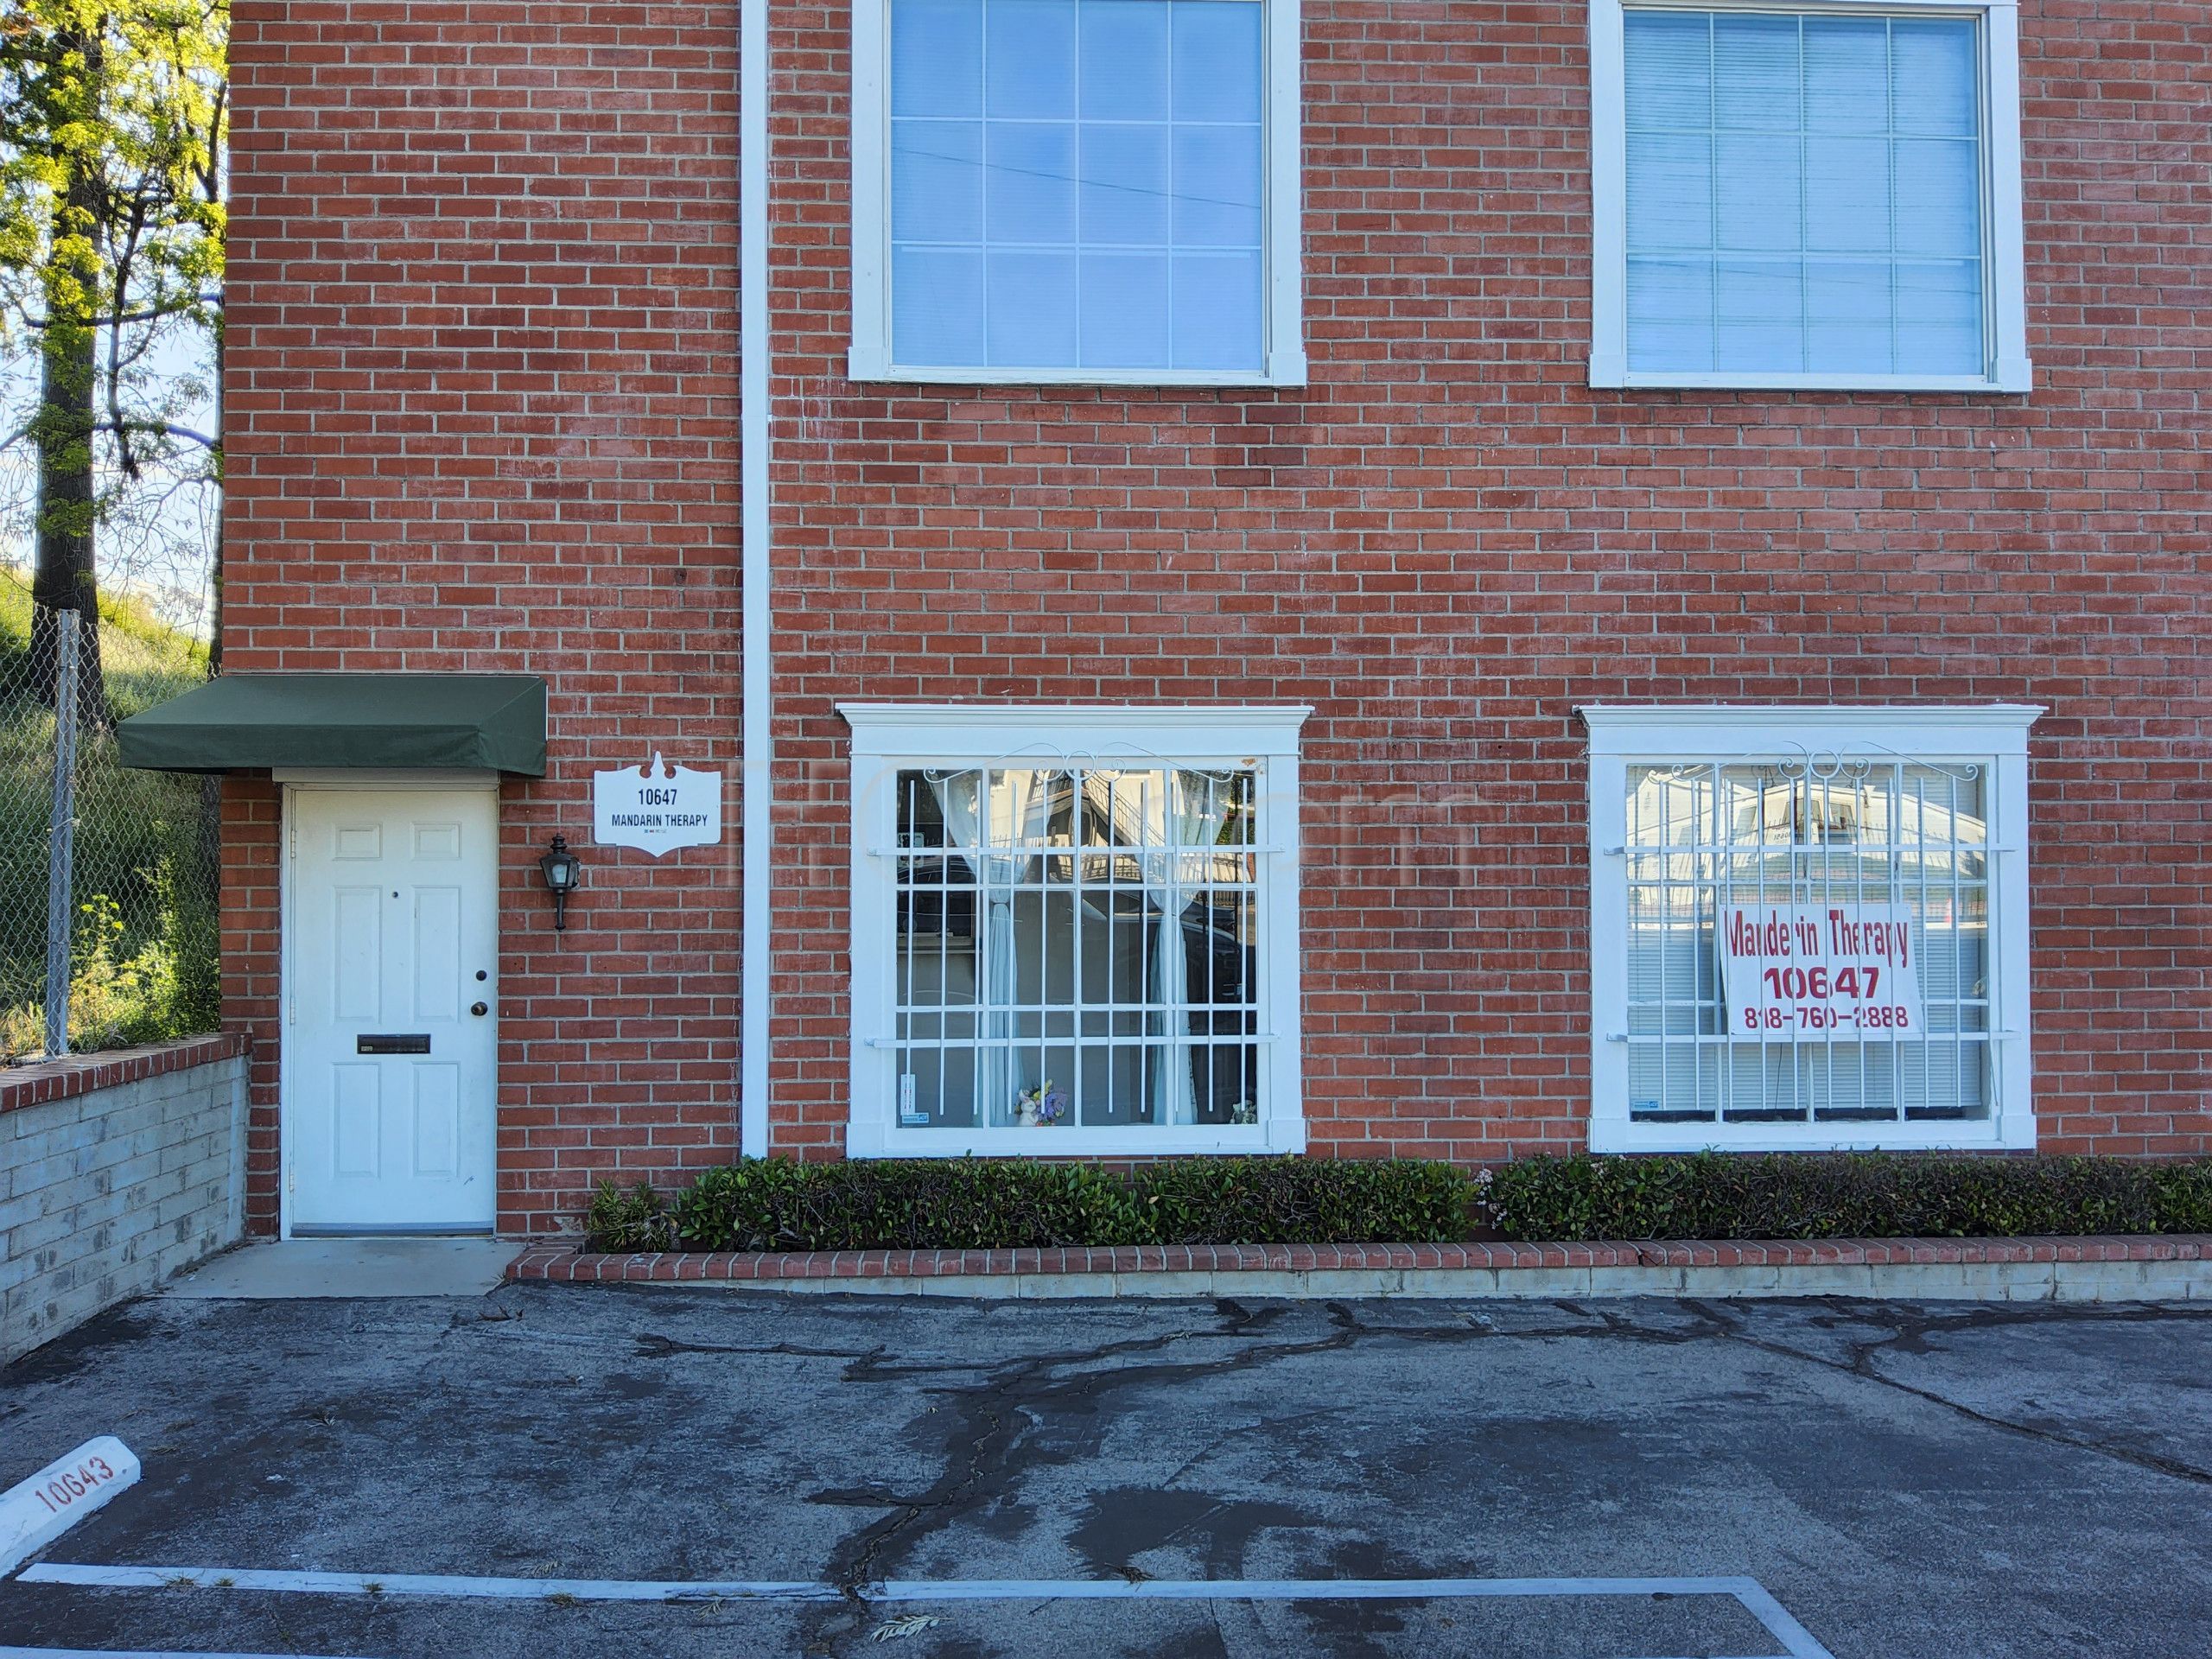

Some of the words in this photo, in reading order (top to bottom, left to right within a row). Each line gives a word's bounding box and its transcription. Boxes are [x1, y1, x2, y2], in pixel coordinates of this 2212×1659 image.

[638, 788, 677, 805] 10647
[612, 814, 662, 827] MANDARIN
[665, 814, 708, 827] THERAPY
[1829, 909, 1908, 968] Therapy
[1764, 966, 1879, 999] 10647
[35, 1456, 114, 1513] 10643
